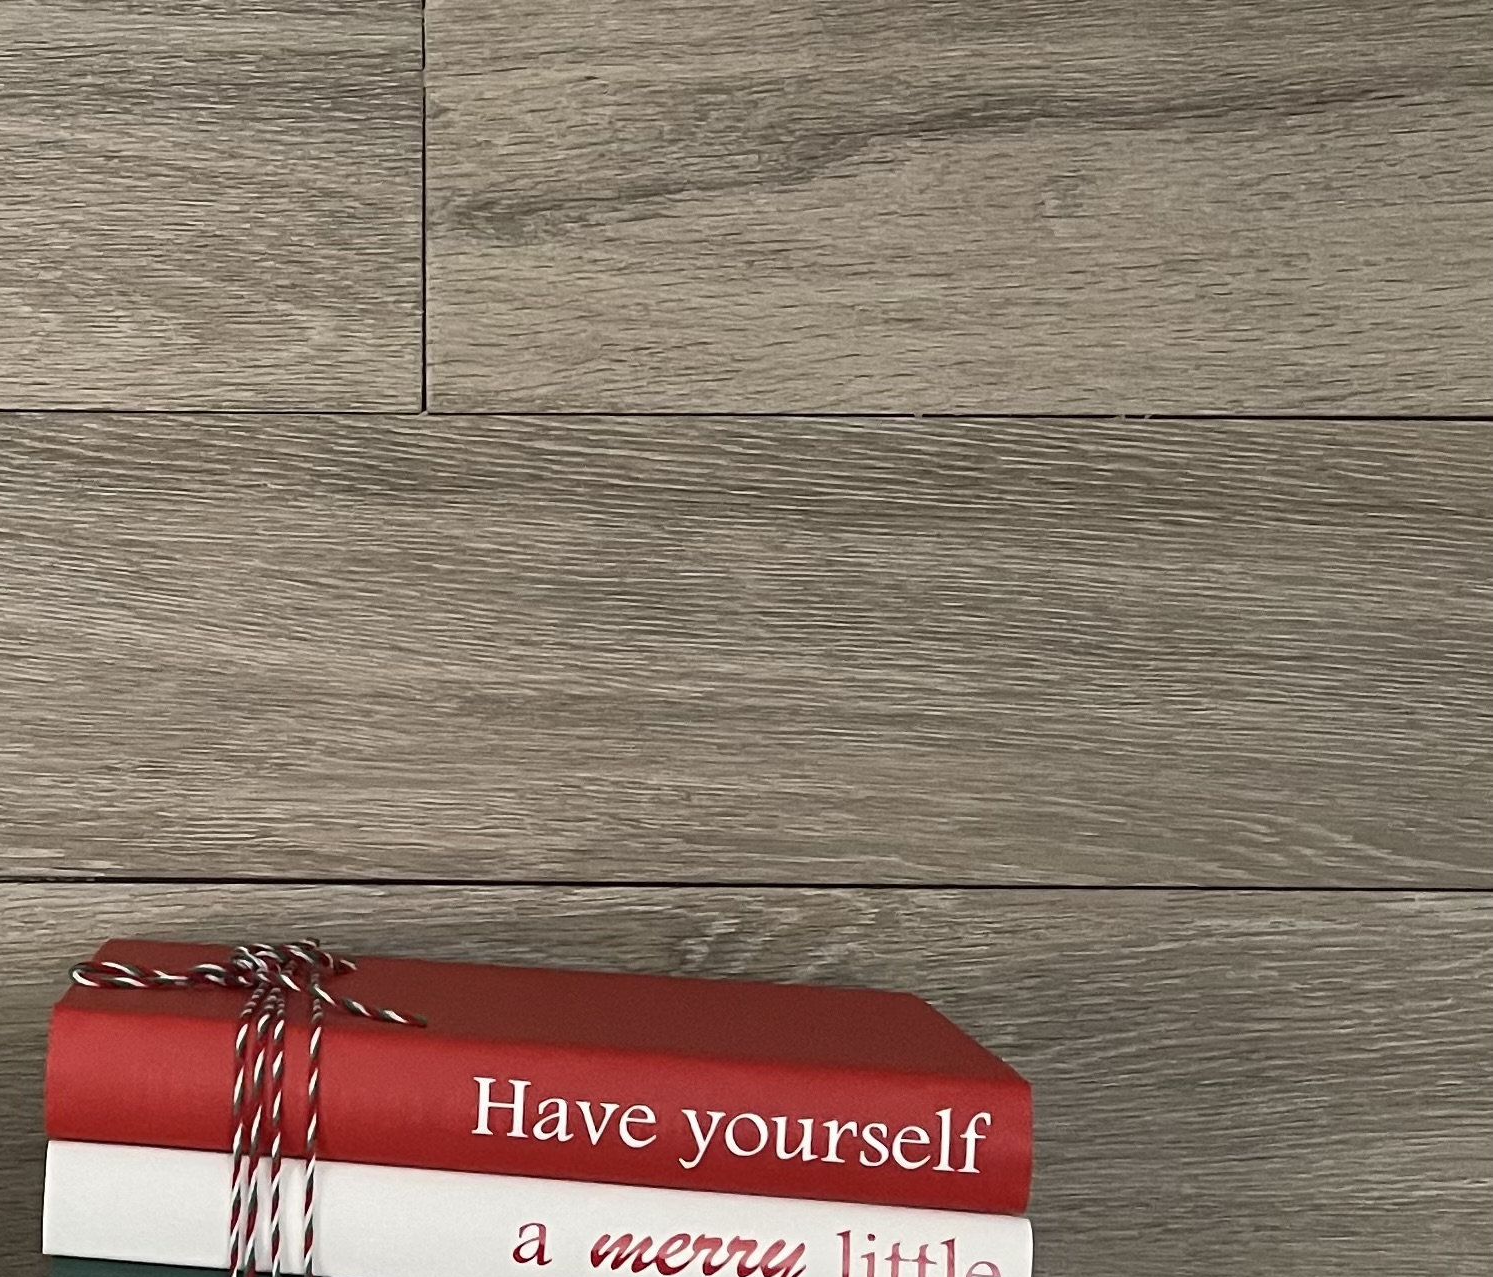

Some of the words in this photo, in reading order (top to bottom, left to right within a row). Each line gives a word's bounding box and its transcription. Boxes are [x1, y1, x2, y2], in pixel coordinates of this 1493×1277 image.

[471, 1076, 658, 1149] Have
[678, 1107, 993, 1174] yourself
[512, 1221, 553, 1267] a
